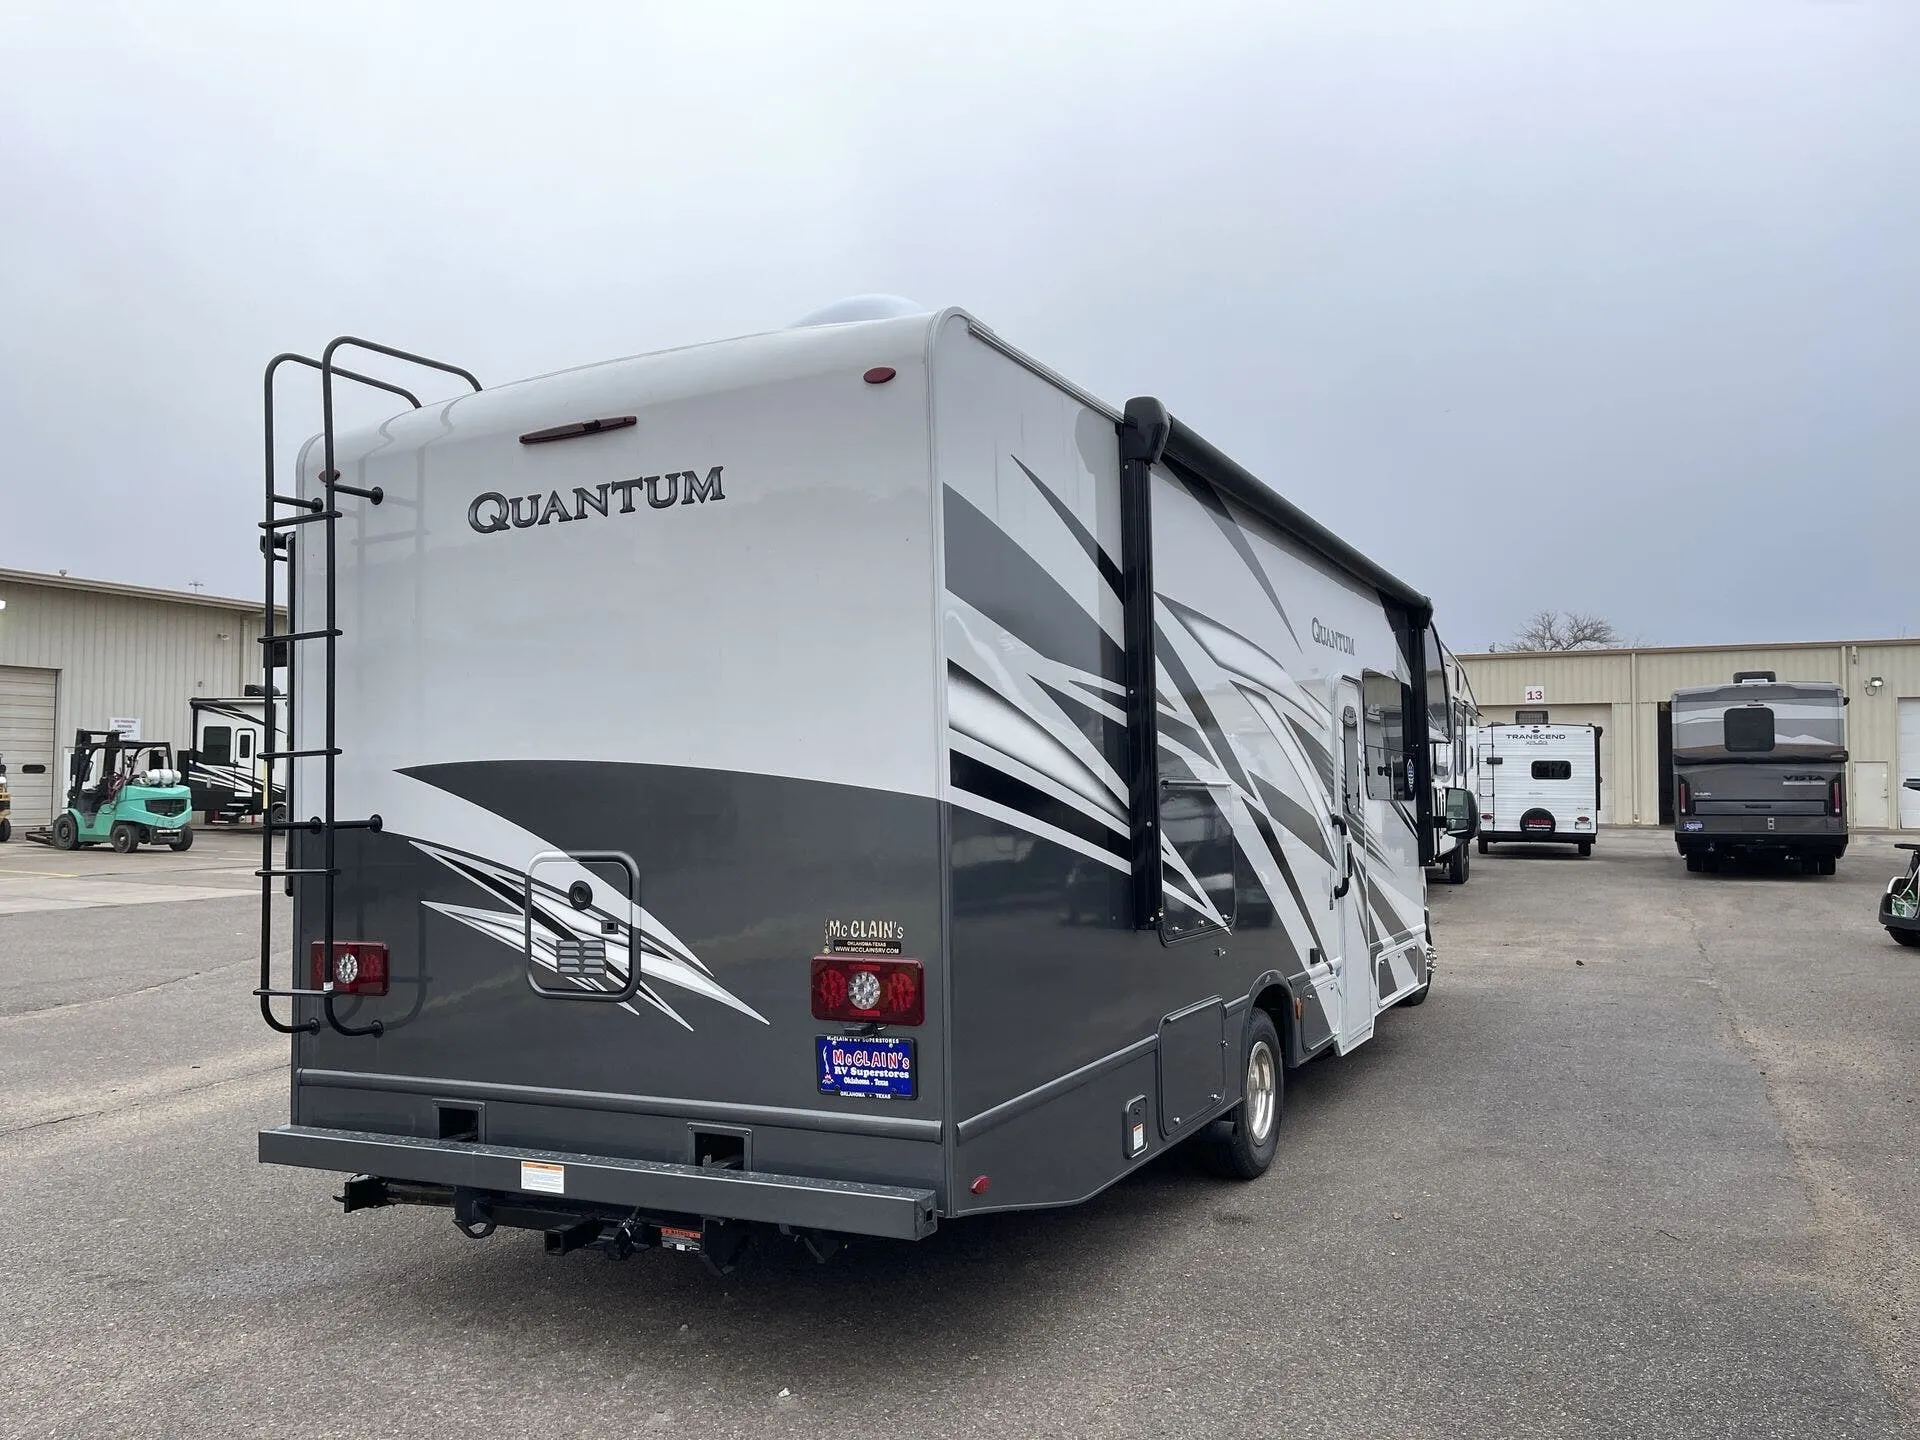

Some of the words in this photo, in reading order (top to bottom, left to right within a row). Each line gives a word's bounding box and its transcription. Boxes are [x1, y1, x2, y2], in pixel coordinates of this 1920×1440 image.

[468, 466, 726, 534] QUANTUM
[1311, 617, 1355, 657] QUANTUM
[1526, 690, 1543, 701] 13
[834, 1066, 848, 1075] RV
[851, 1067, 909, 1078] Superstores
